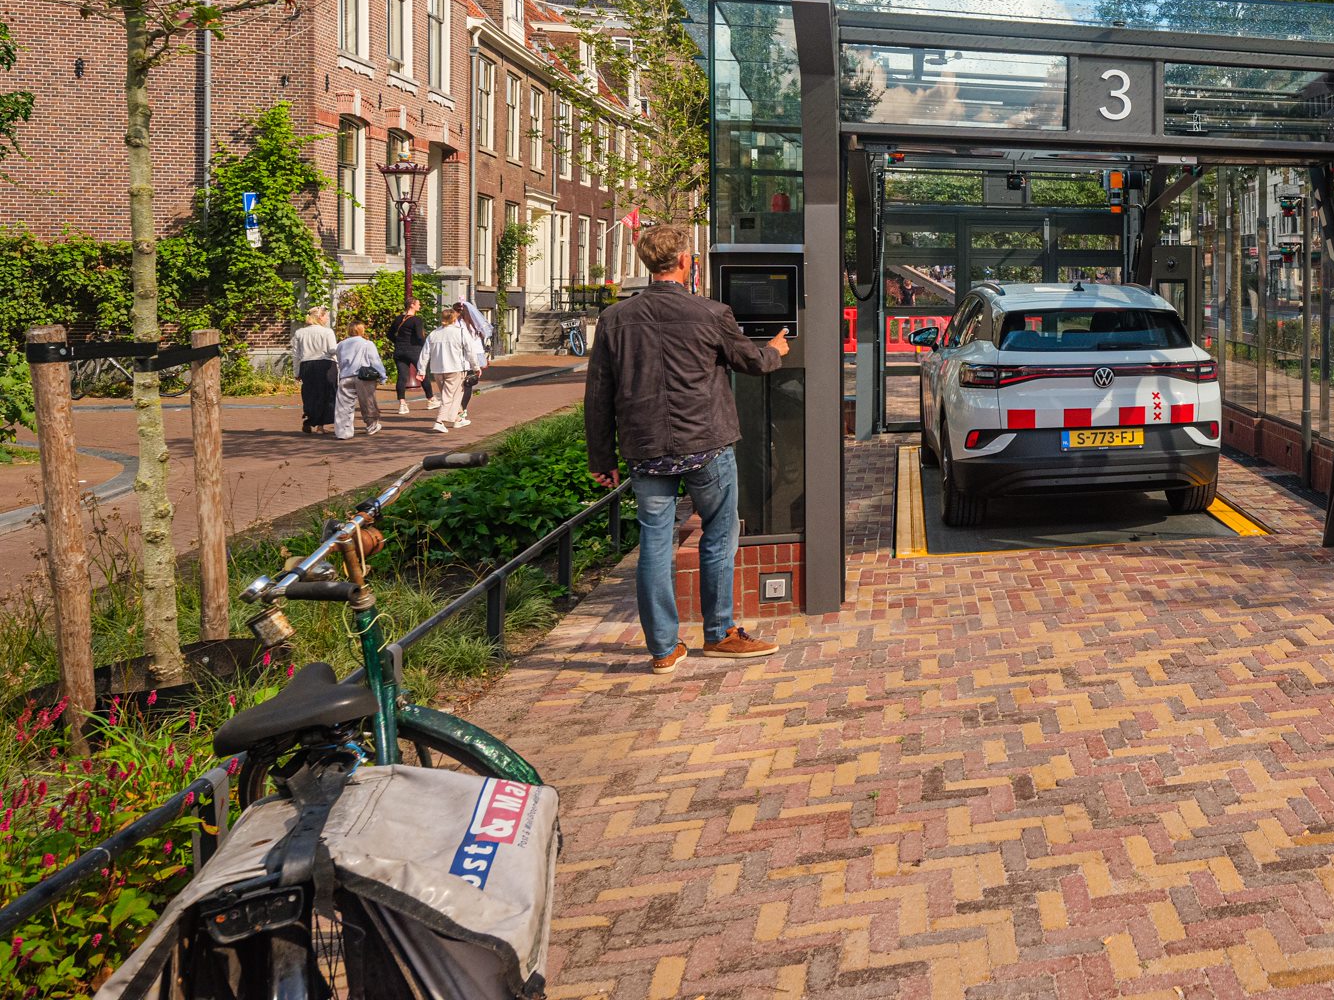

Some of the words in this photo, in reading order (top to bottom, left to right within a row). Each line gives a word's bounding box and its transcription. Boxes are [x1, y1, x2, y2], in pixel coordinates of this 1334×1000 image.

[1099, 69, 1132, 121] 3
[1077, 430, 1135, 445] S-773-FJ
[460, 844, 494, 888] ost
[491, 779, 527, 813] Mai
